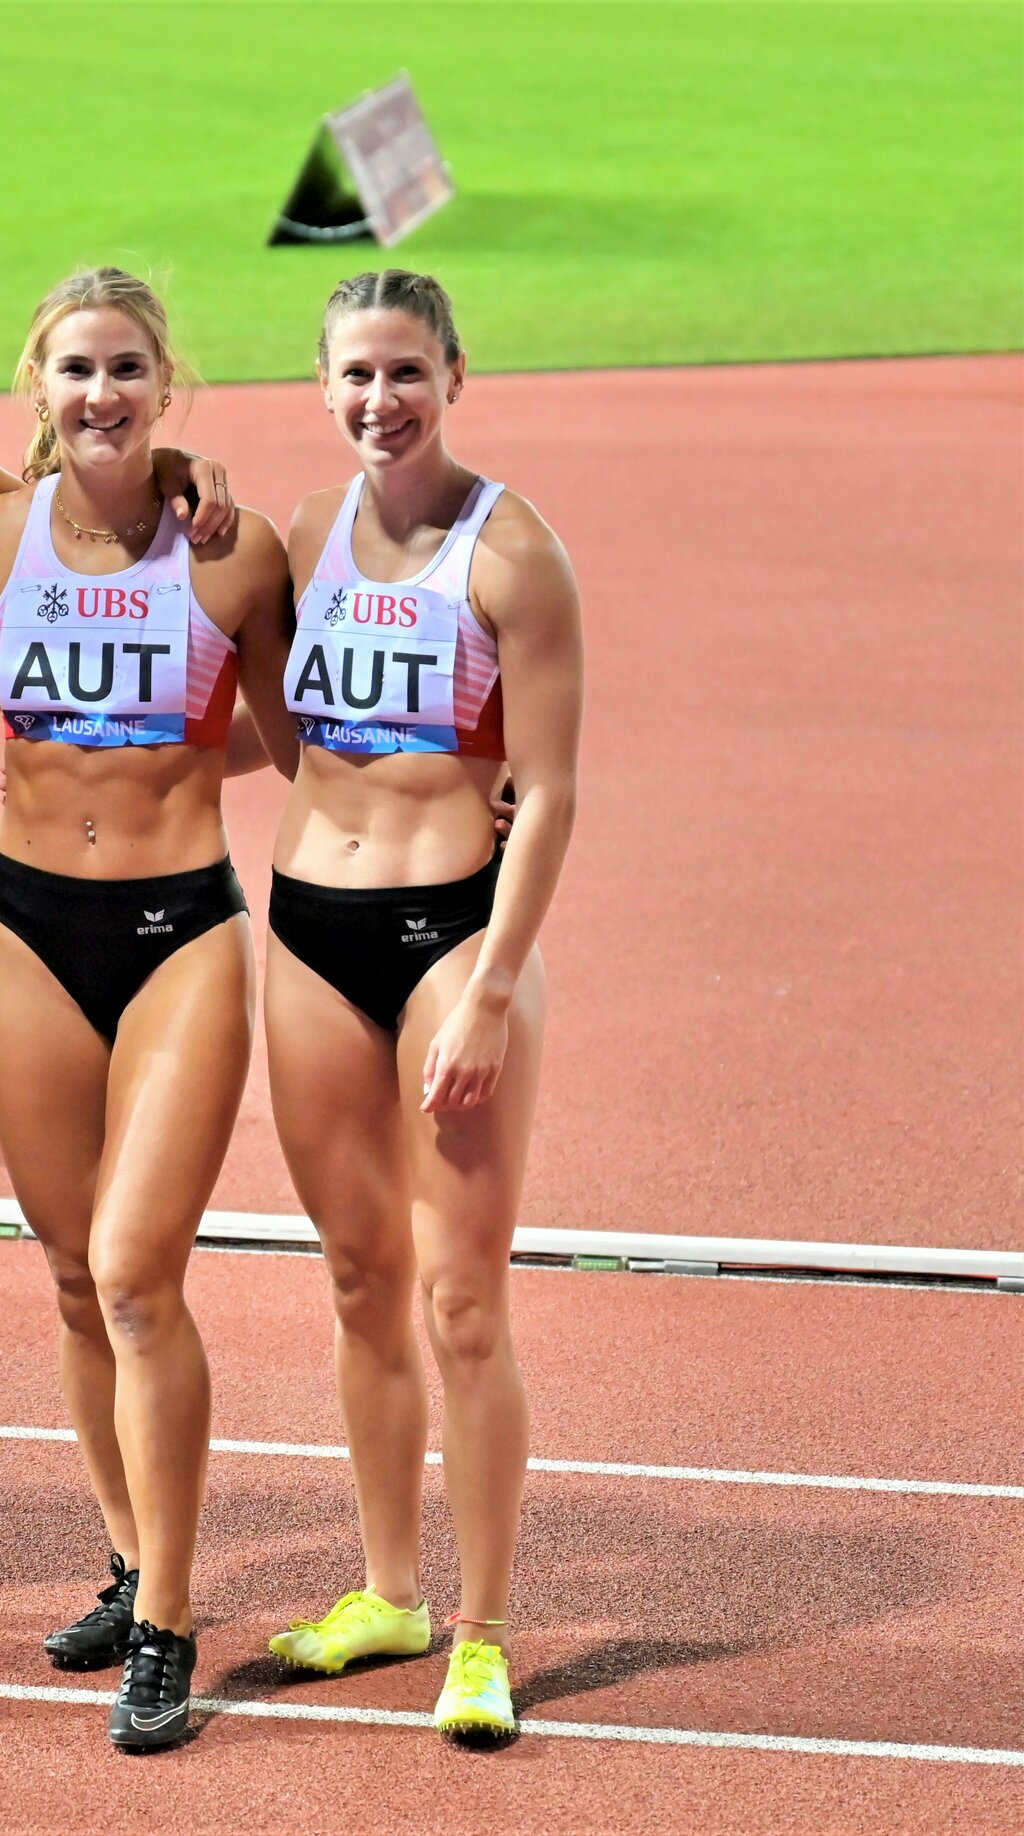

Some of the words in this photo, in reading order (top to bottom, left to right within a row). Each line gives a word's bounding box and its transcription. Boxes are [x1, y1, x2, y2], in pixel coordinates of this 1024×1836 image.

[76, 587, 150, 619] UBS
[352, 592, 418, 628] UBS
[9, 641, 171, 703] AUT
[293, 644, 438, 713] AUT
[52, 715, 146, 737] LAUSANNE
[324, 723, 417, 744] LAUSANNE
[137, 924, 174, 935] erima
[401, 931, 438, 942] erima
